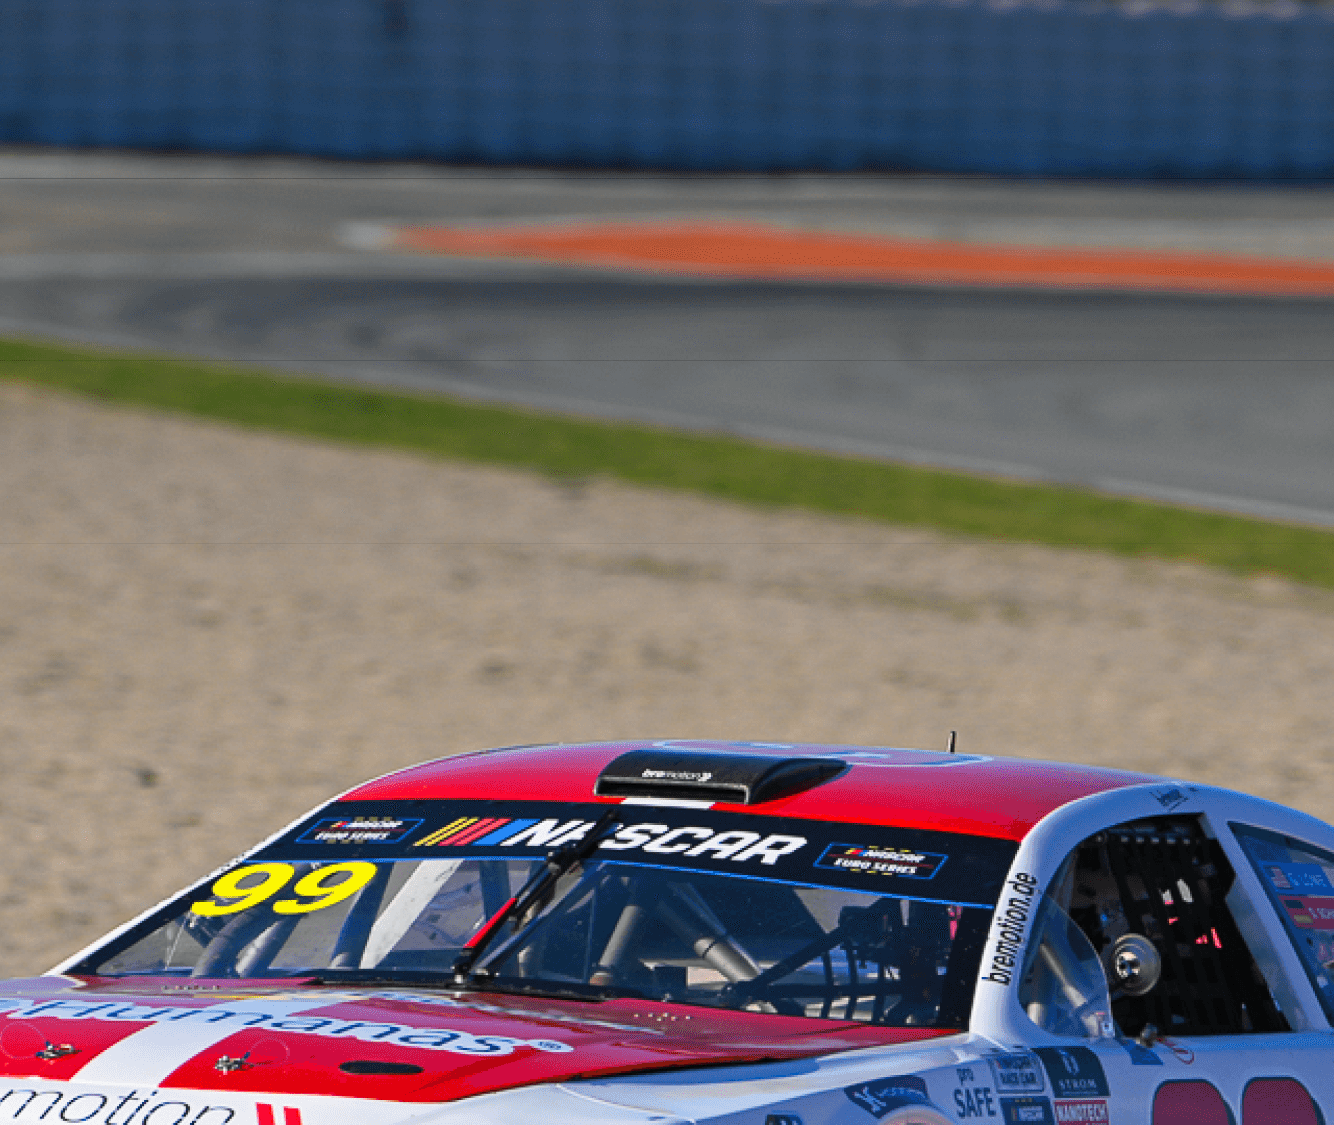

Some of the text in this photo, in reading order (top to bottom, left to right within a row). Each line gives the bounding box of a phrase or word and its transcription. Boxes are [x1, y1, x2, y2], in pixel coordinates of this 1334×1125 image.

[190, 861, 378, 917] 99
[981, 871, 1039, 987] bremotion.de
[954, 1087, 997, 1119] SAFE
[1056, 1104, 1108, 1122] NANOTECH
